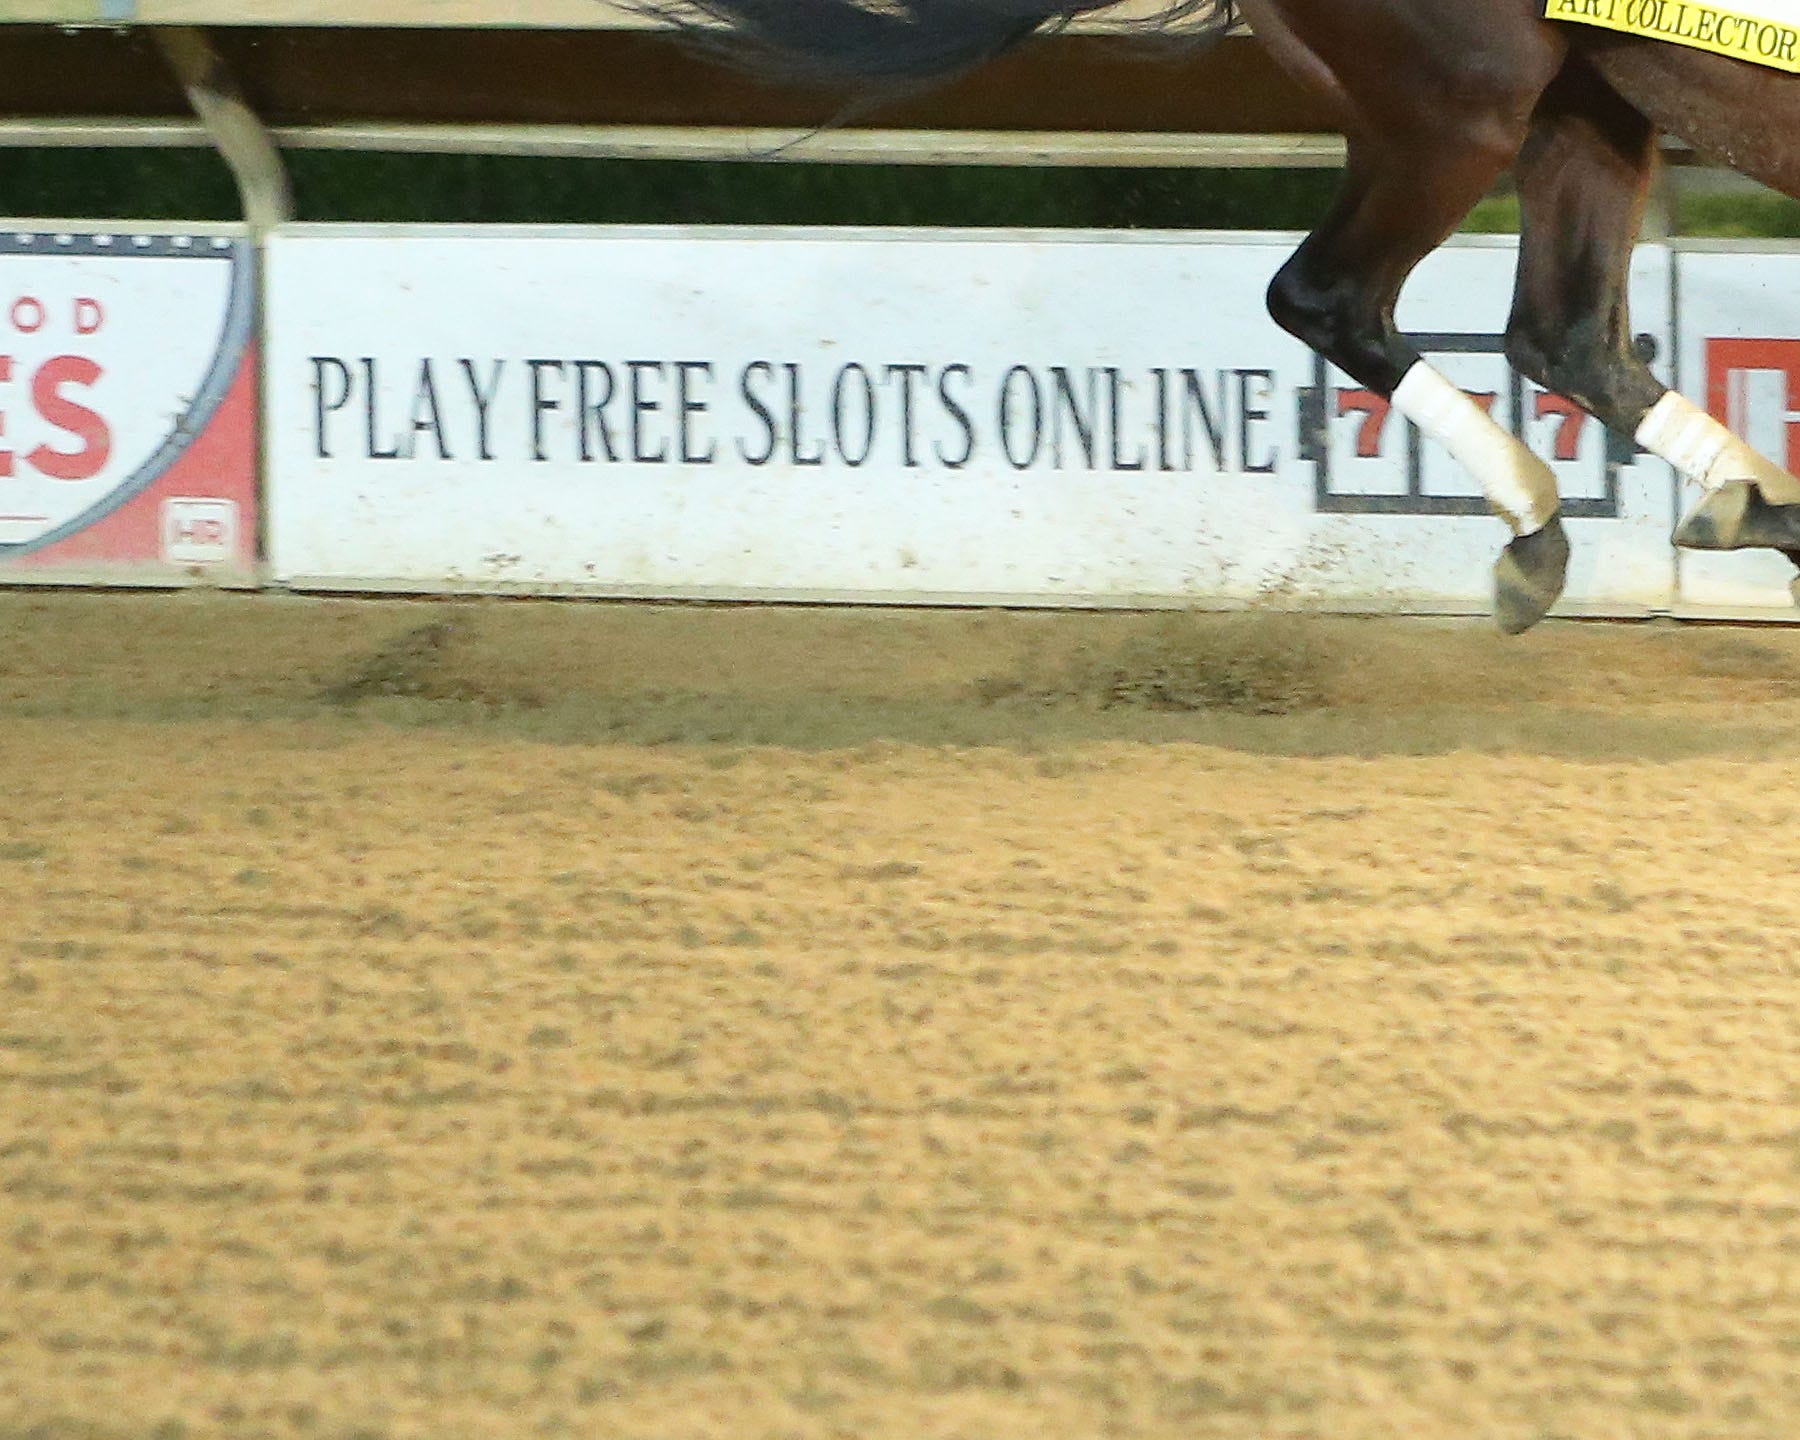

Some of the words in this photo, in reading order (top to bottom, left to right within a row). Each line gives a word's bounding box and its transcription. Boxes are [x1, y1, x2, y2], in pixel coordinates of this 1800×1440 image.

[309, 356, 503, 460] PLAY
[525, 359, 717, 465] FREE
[736, 360, 977, 469] SLOTS
[999, 363, 1276, 473] ONLINE
